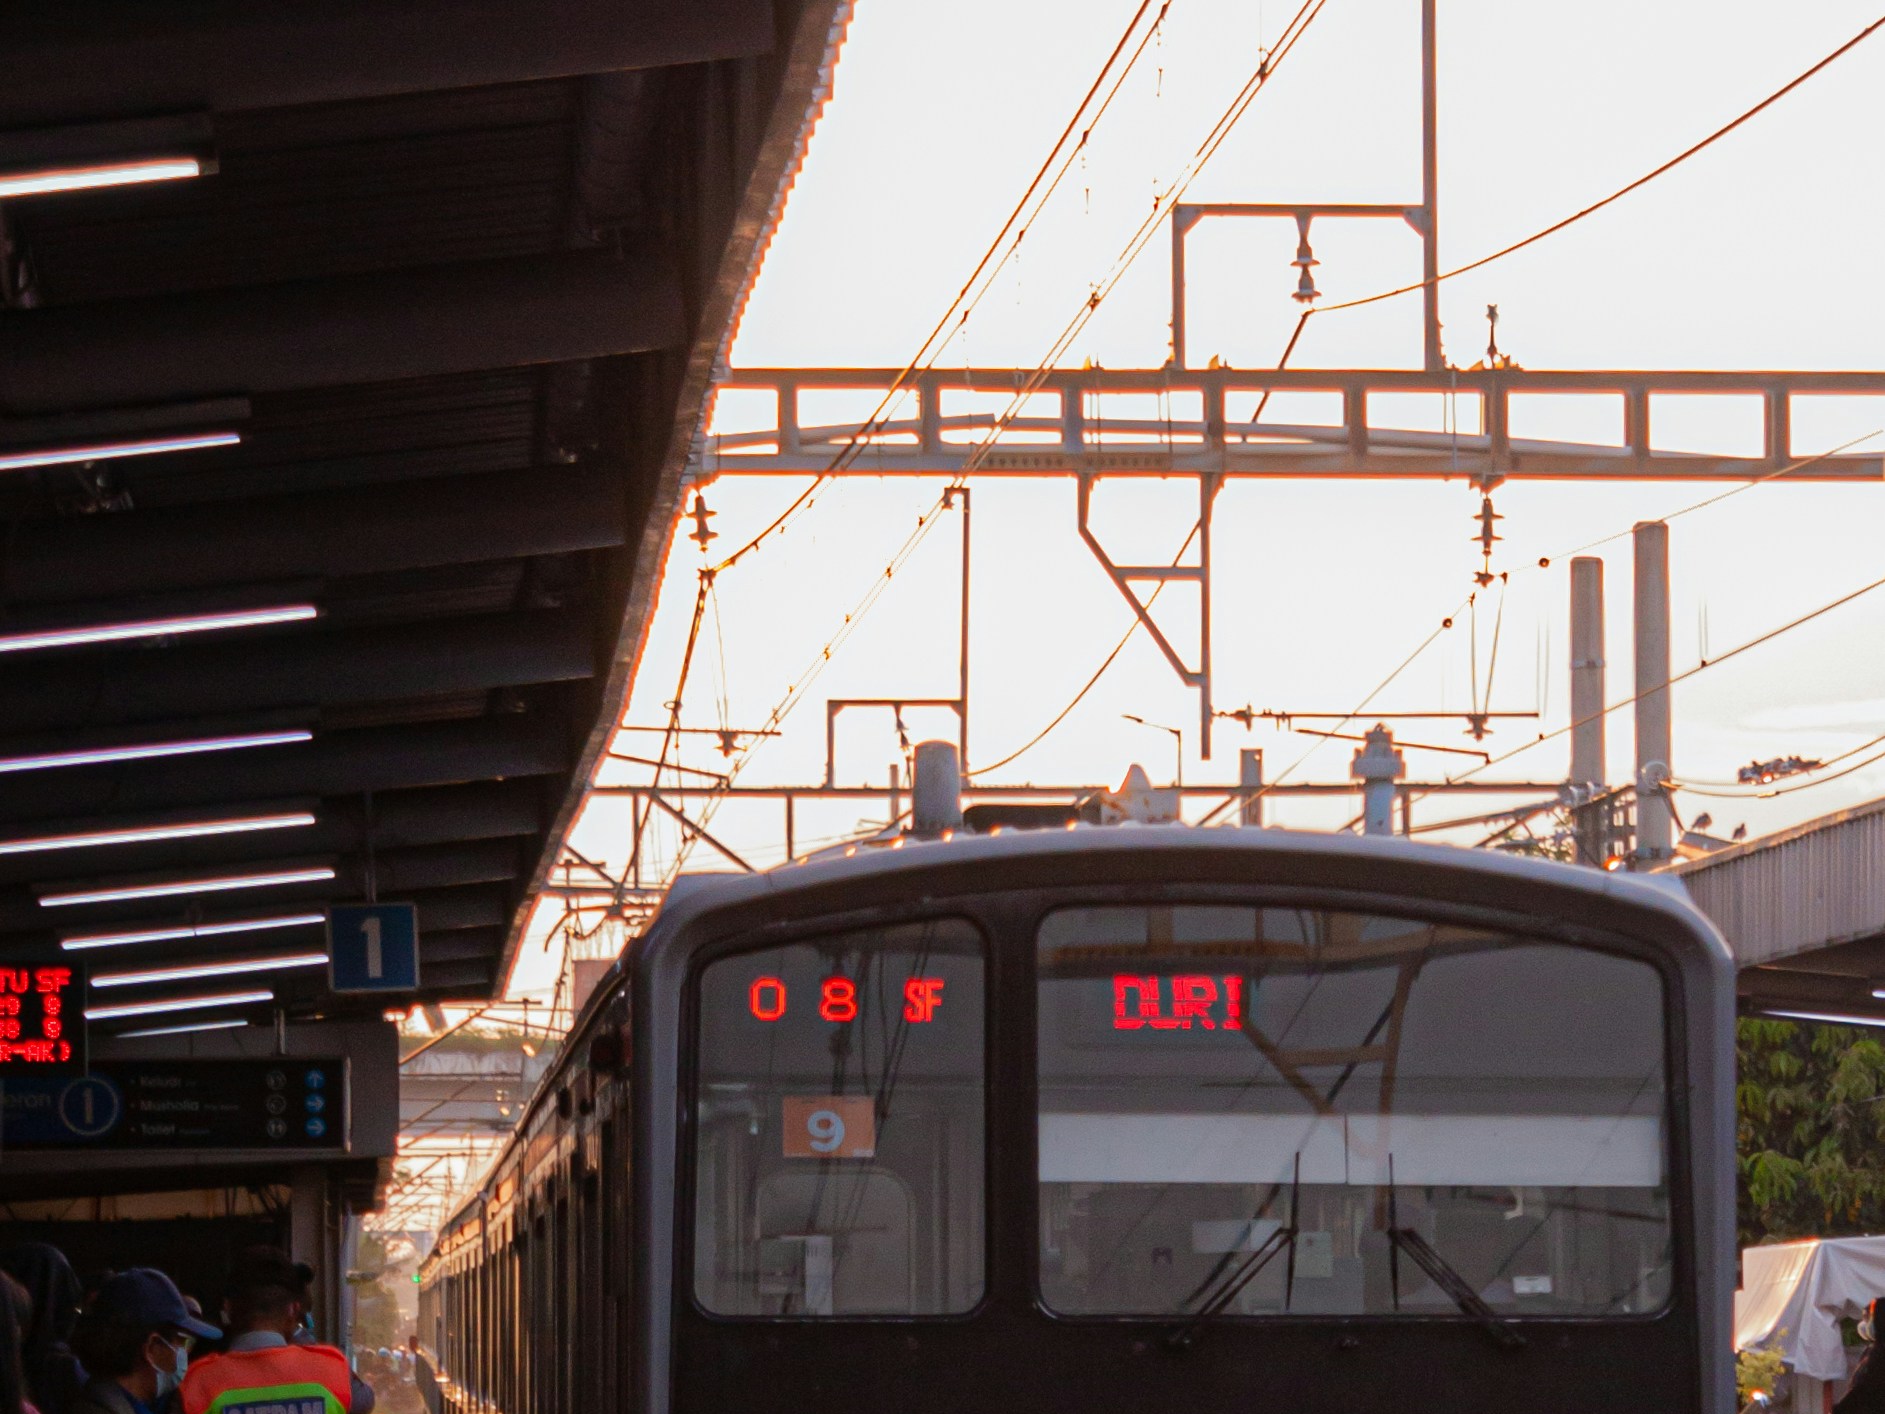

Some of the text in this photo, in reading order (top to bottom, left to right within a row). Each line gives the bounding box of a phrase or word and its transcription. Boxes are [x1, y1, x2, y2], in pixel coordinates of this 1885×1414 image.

[360, 916, 383, 979] 1
[35, 967, 72, 993] SF
[904, 977, 946, 1023] SF
[1113, 973, 1243, 1030] DURI
[83, 1087, 95, 1125] 1
[807, 1110, 845, 1152] 9
